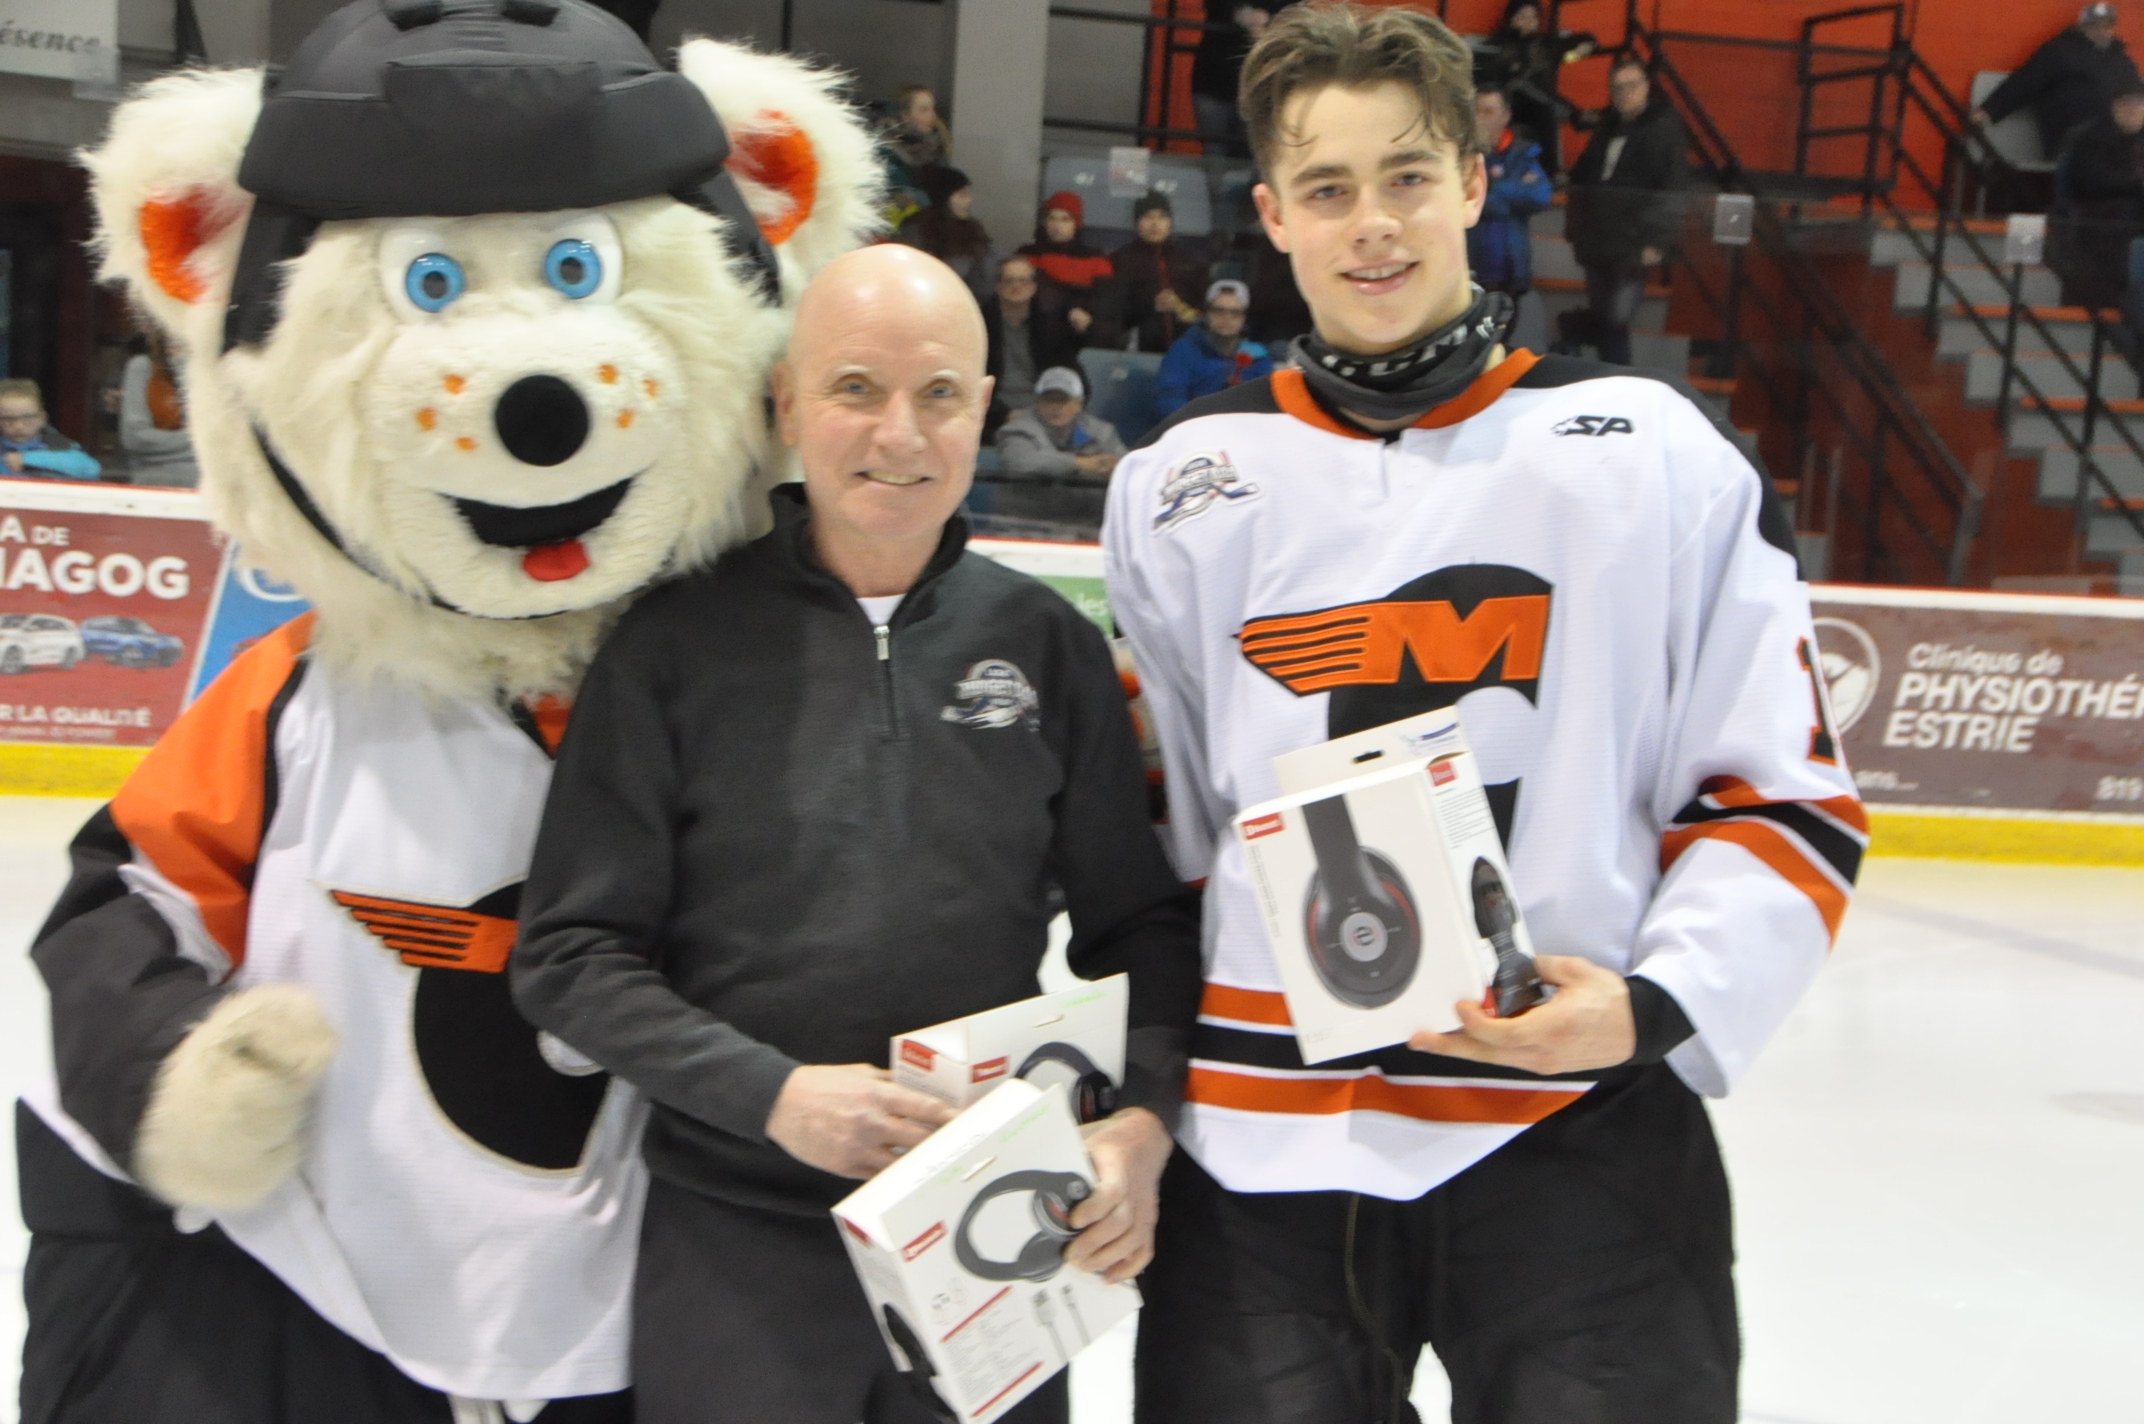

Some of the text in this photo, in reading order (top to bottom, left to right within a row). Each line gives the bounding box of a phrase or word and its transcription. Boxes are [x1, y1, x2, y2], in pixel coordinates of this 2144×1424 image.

[1563, 415, 1634, 437] SP
[31, 525, 70, 546] DE
[0, 547, 190, 599] AGOG
[1907, 642, 2065, 676] Clinique de
[16, 704, 48, 723] LA
[51, 706, 152, 727] QUALITÉ
[1883, 710, 2040, 752] ESTRIE
